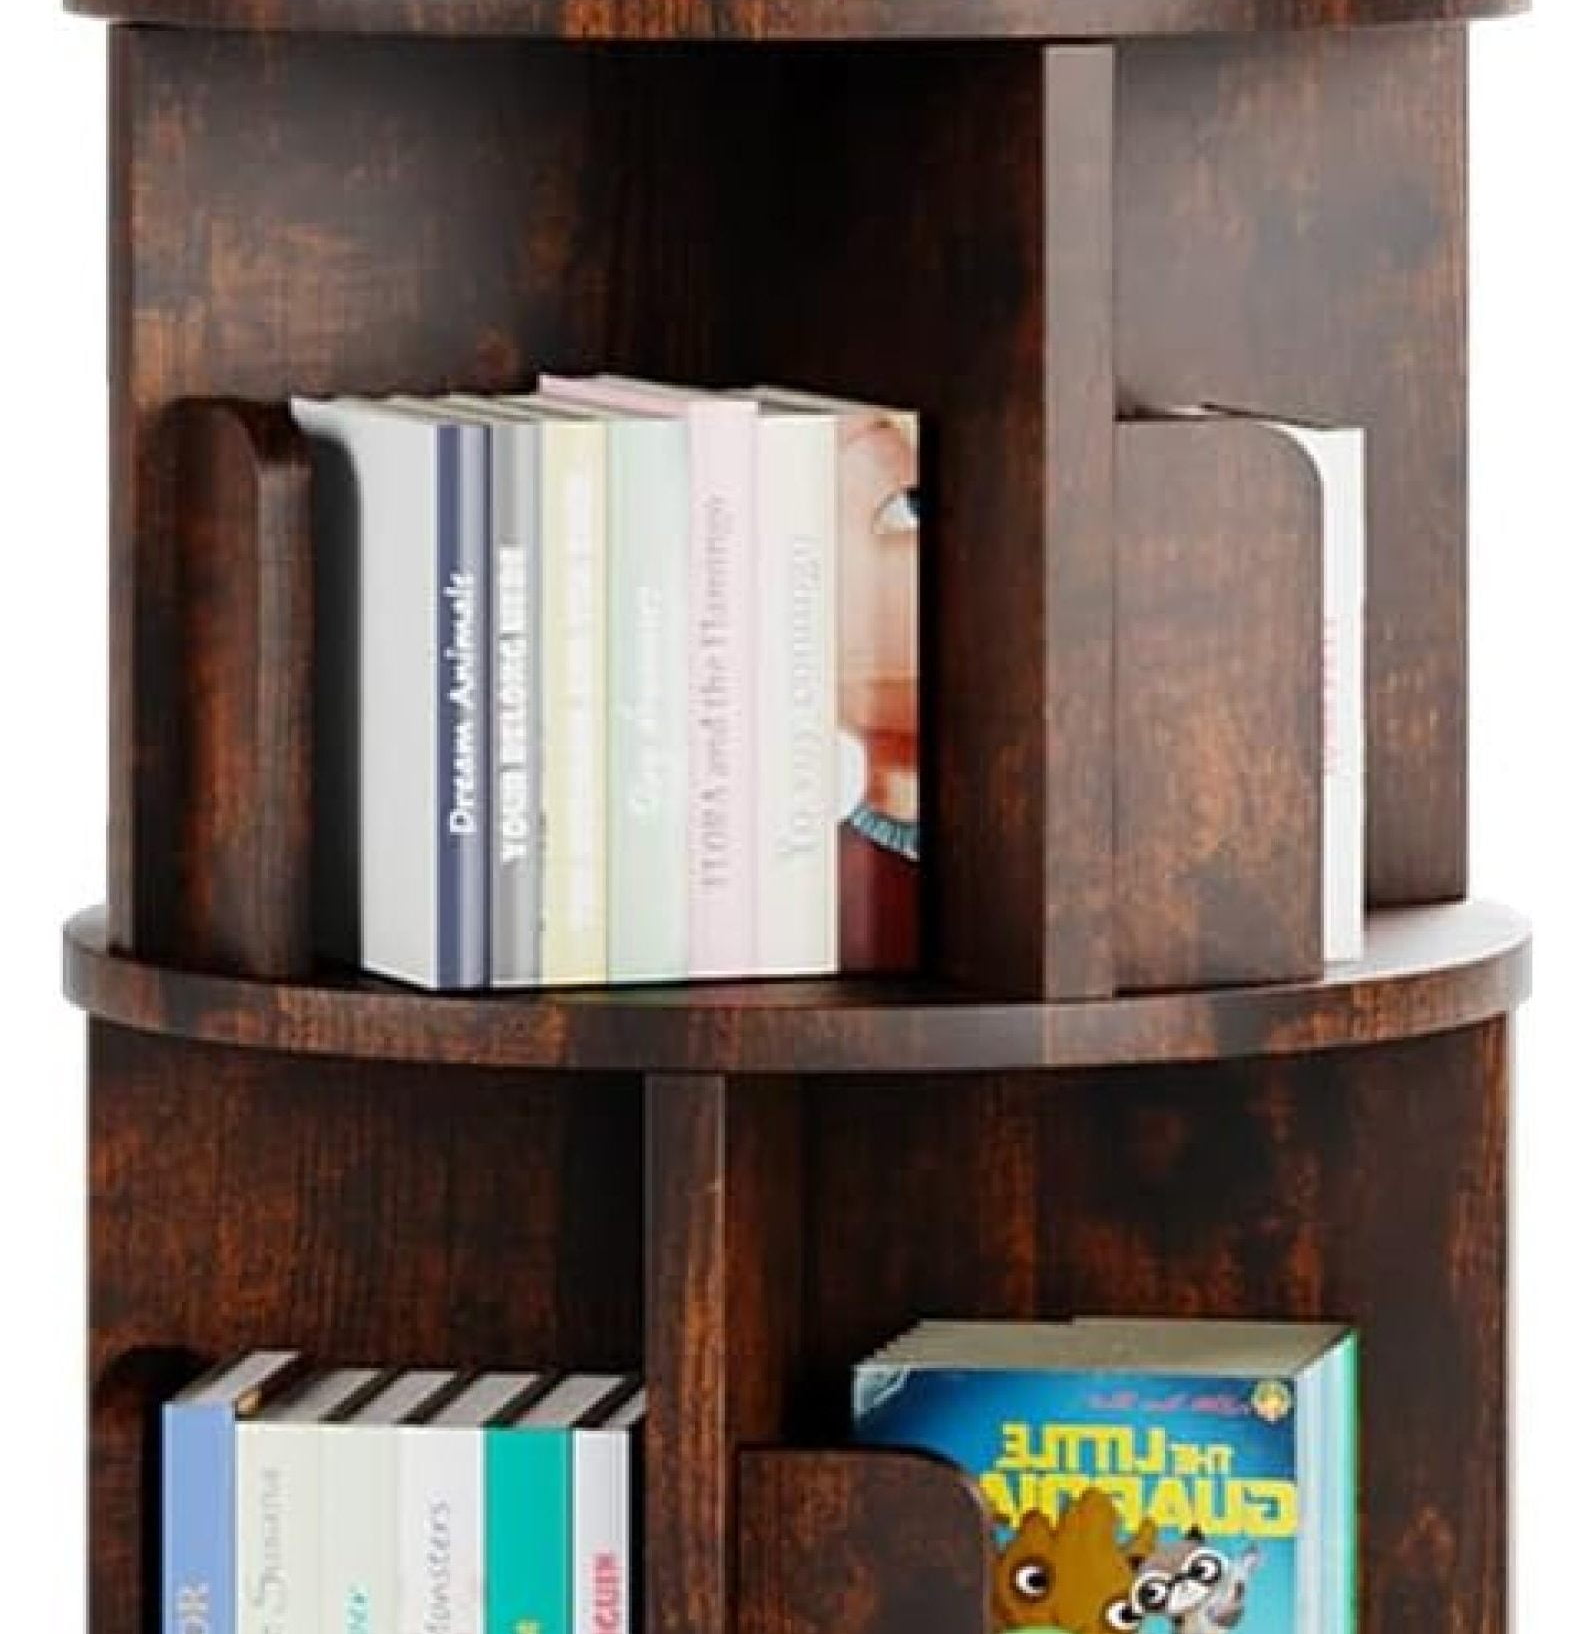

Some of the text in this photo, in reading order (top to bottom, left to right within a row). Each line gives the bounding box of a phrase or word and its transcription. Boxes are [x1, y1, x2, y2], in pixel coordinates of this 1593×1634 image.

[442, 570, 476, 835] Dream Animals
[700, 656, 729, 708] the
[700, 718, 729, 780] and
[249, 1466, 287, 1615] Susana
